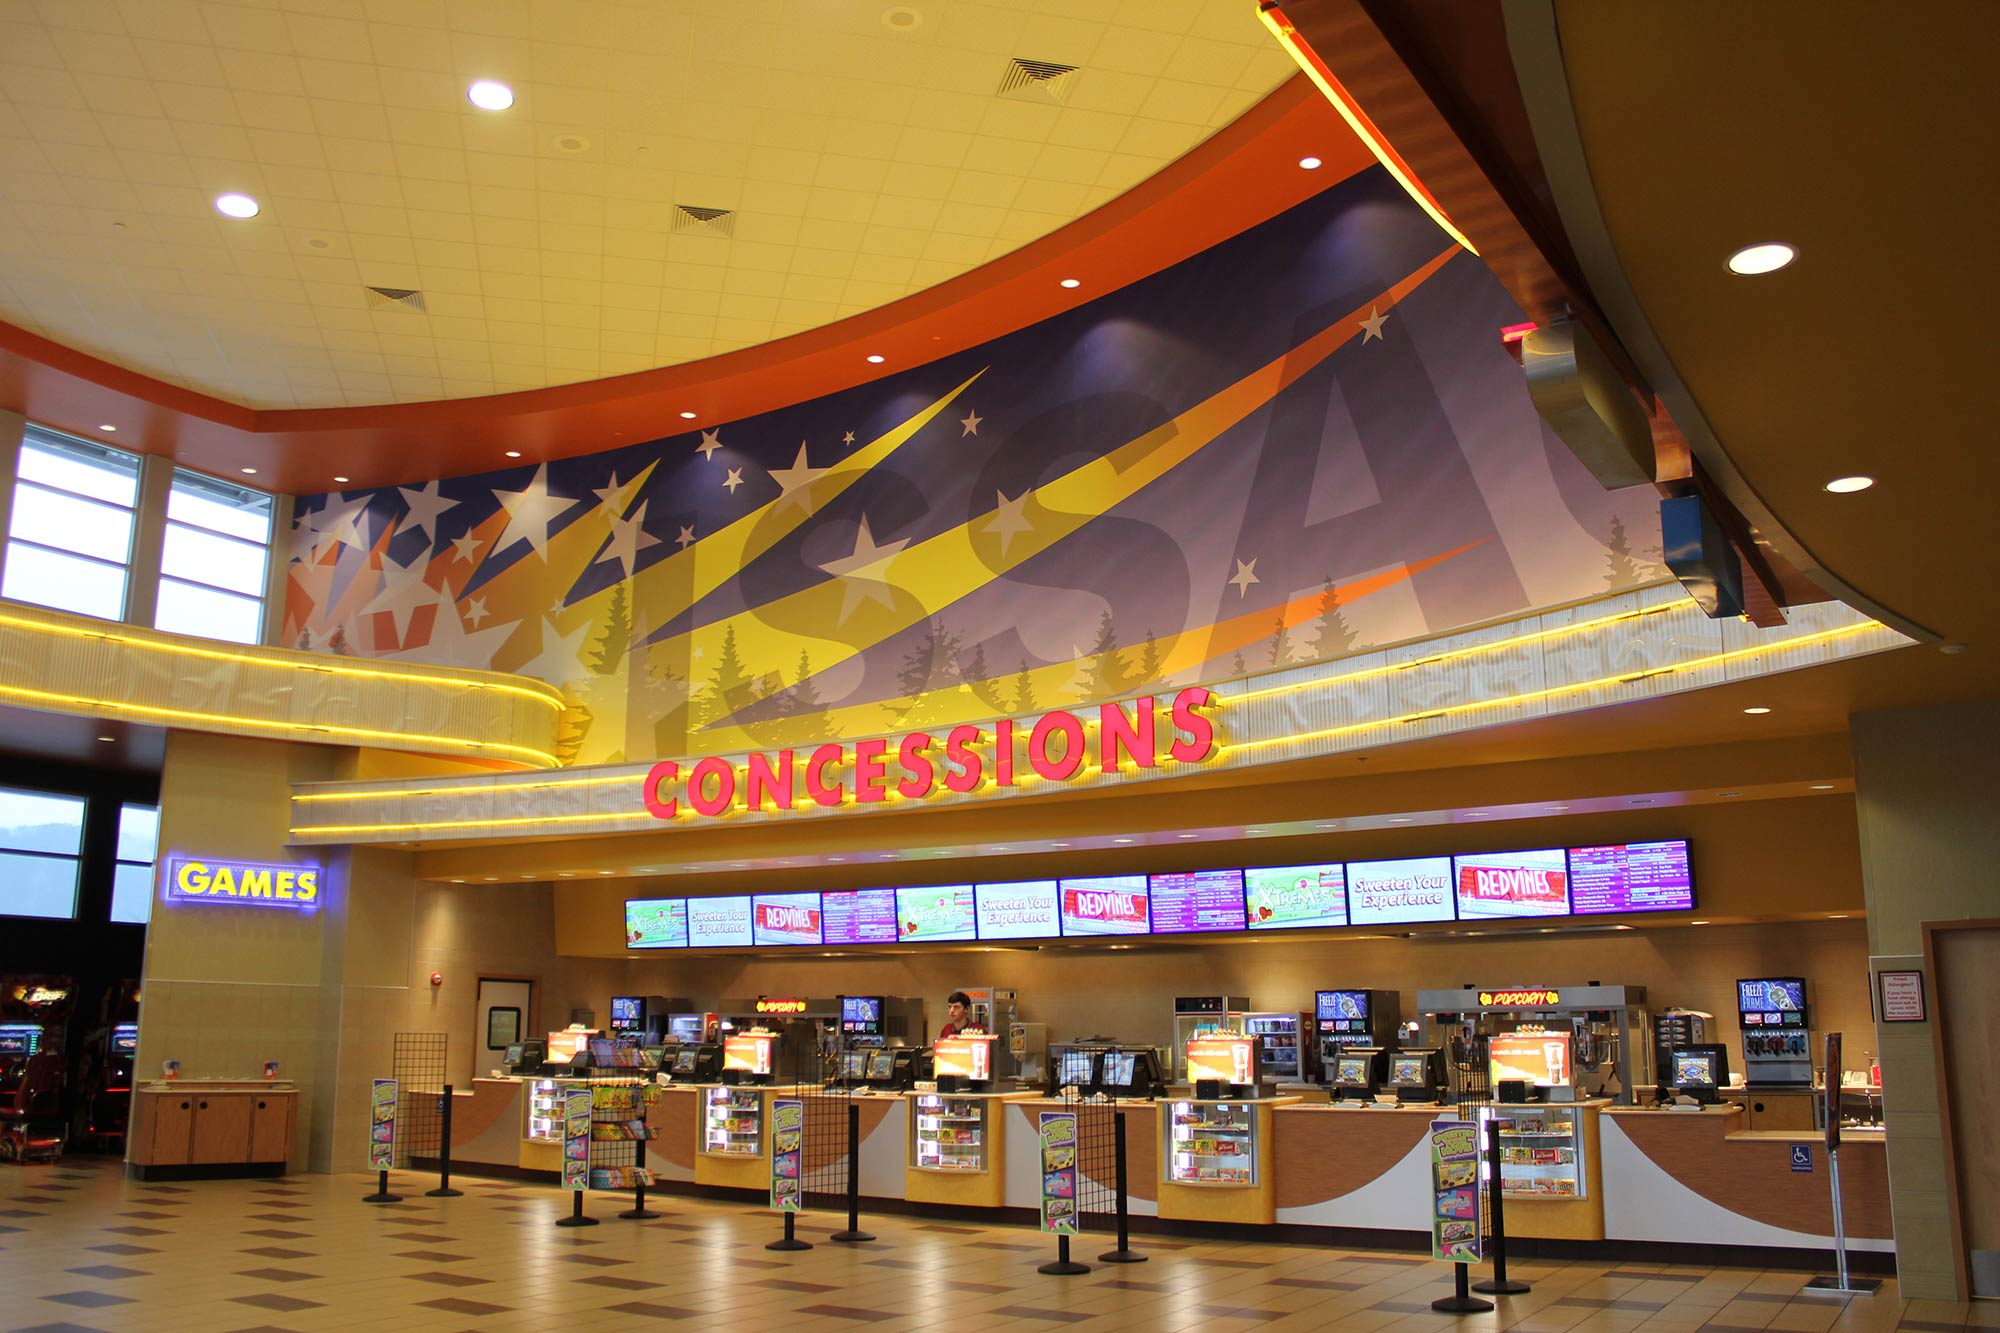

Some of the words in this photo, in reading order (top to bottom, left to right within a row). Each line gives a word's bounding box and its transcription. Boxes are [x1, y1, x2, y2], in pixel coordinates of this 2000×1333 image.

[642, 686, 1216, 819] CONCESSIONS
[177, 862, 317, 900] GAMES
[1355, 878, 1412, 893] Sweeten
[1414, 875, 1447, 889] Your
[982, 898, 1026, 912] Sweeten
[1028, 896, 1054, 910] Your
[1361, 892, 1442, 910] Experience
[693, 911, 727, 922] Sweeten
[728, 910, 748, 920] Your
[987, 911, 1050, 927] Experience
[696, 924, 745, 936] Experience
[1742, 983, 1764, 997] FREEZE
[1493, 992, 1547, 1006] POPCORN
[1743, 997, 1764, 1009] FRAME
